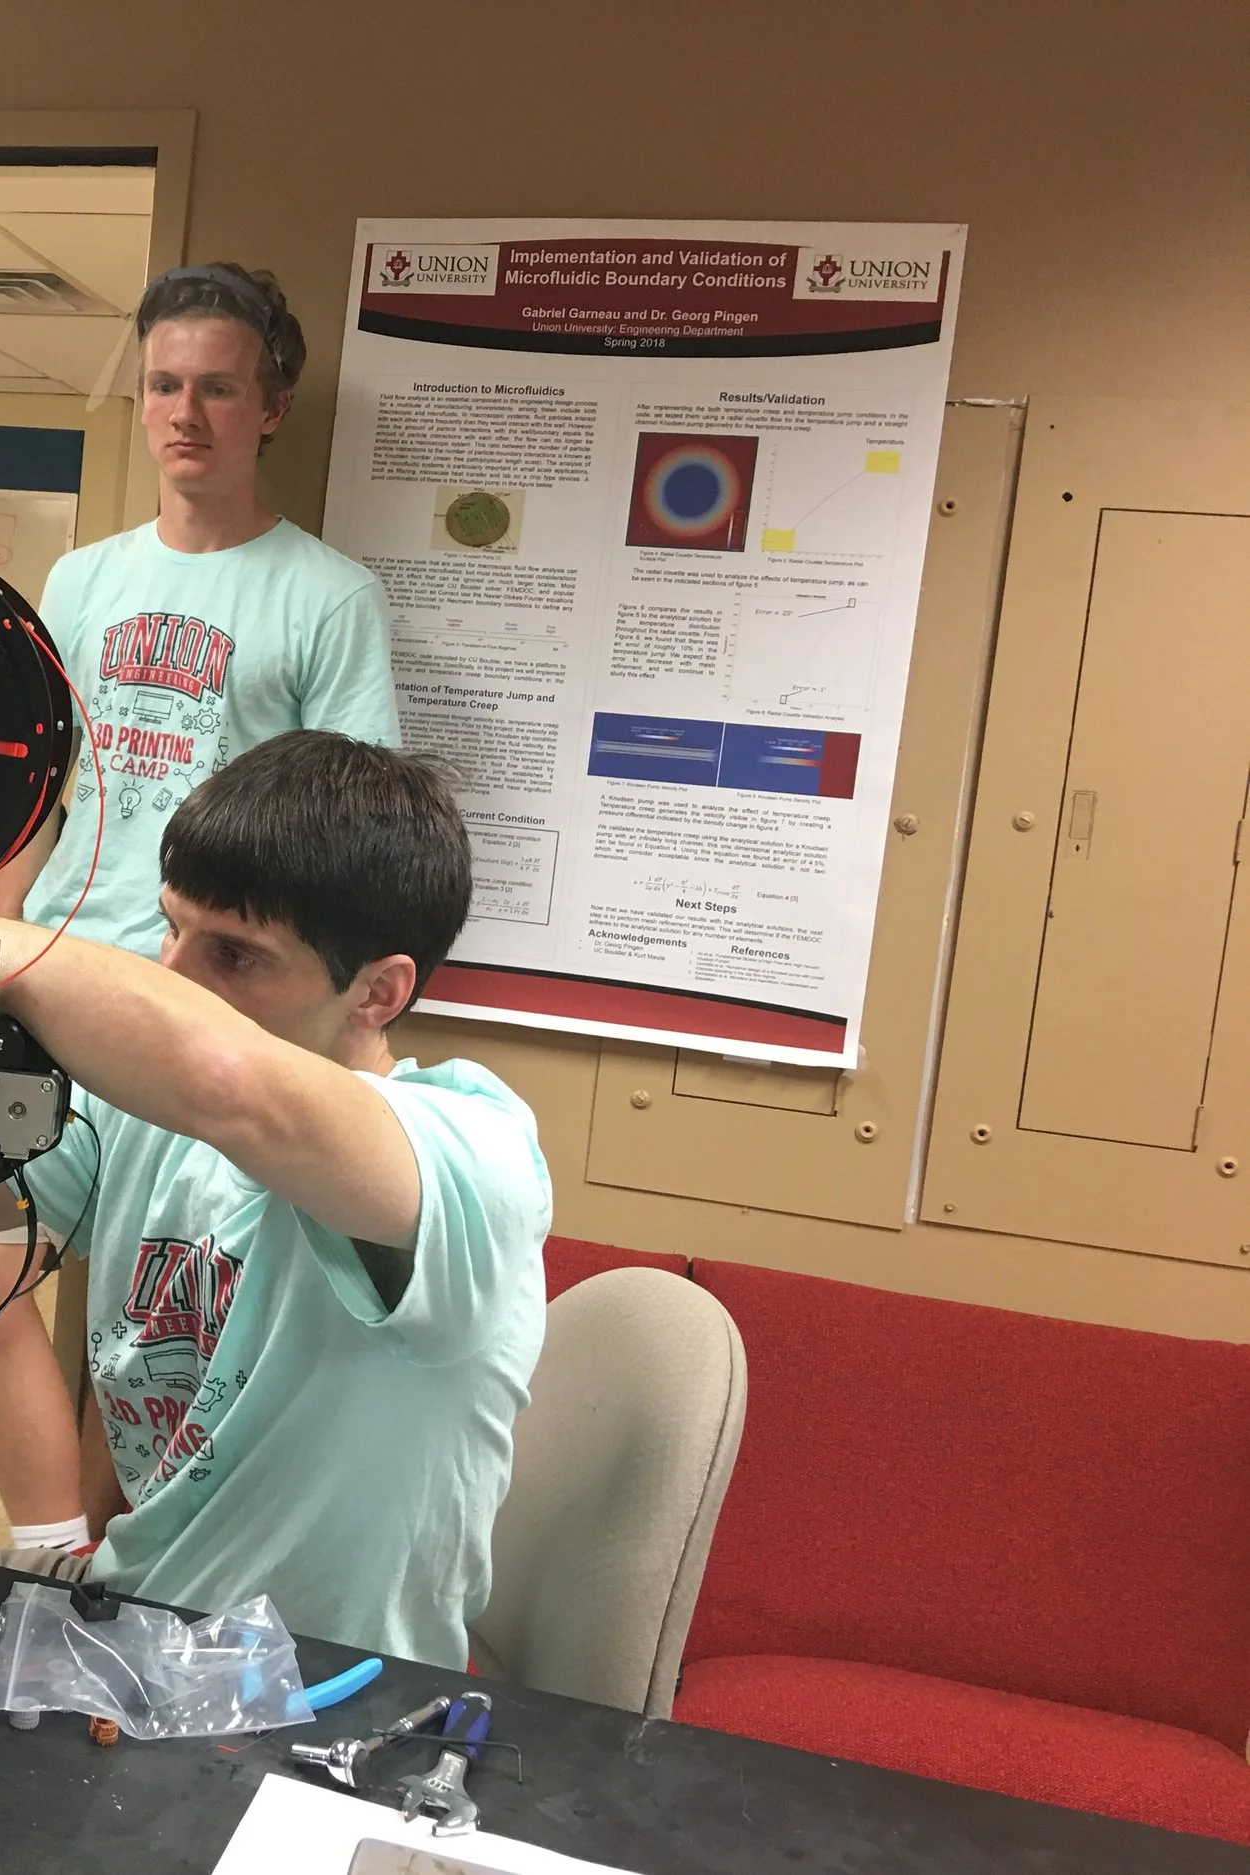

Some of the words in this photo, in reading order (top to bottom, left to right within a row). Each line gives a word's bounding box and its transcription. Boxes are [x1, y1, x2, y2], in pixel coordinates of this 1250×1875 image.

[418, 256, 489, 273] UNION
[510, 249, 637, 266] Implementation
[642, 250, 674, 266] and
[680, 251, 763, 266] Validation
[768, 252, 787, 267] of
[849, 260, 931, 278] UNION
[417, 273, 487, 284] UNIVERSITY
[505, 271, 600, 286] Microfluidic
[605, 272, 687, 289] Boundary
[692, 272, 787, 288] Conditions
[848, 278, 928, 290] UNIVERSITY
[522, 307, 565, 319] Gabriel
[568, 308, 620, 320] Garneau
[624, 309, 647, 320] and
[651, 309, 667, 320] Dr.
[672, 309, 709, 323] Georg
[714, 311, 758, 324] Pingen
[532, 322, 561, 332] Union
[619, 324, 680, 337] Engineering
[683, 325, 744, 337] Department
[604, 337, 636, 349] Spring
[640, 338, 665, 348] 2018
[413, 383, 478, 394] Introduction
[480, 384, 491, 394] to
[495, 385, 565, 396] Microfluidics
[719, 391, 826, 406] Results/Validation
[866, 437, 905, 446] Temperature
[724, 573, 748, 581] analyze
[790, 577, 827, 585] temperature
[618, 603, 637, 611] Figure
[101, 612, 236, 699] UNION
[395, 683, 428, 693] ntation
[431, 683, 441, 694] of
[443, 685, 503, 699] Temperature
[506, 691, 533, 703] Jump
[537, 692, 555, 703] and
[408, 695, 467, 709] Temperature
[469, 698, 498, 711] Creep
[94, 722, 113, 750] 3D
[116, 727, 194, 764] PRINTING
[110, 754, 170, 781] CAMP
[608, 795, 634, 803] Knudsen
[701, 804, 725, 812] analyze
[772, 811, 809, 820] temperature
[459, 809, 496, 821] Current
[498, 812, 545, 825] Condition
[482, 838, 507, 846] Equation
[756, 891, 783, 900] Equation
[675, 898, 701, 910] Next
[704, 901, 737, 914] Steps
[646, 911, 672, 919] validated
[736, 921, 764, 929] analytical
[588, 928, 687, 948] Acknowledgements
[605, 941, 622, 949] Georg
[623, 943, 643, 951] Pingen
[604, 948, 627, 956] Boulder
[731, 945, 790, 960] References
